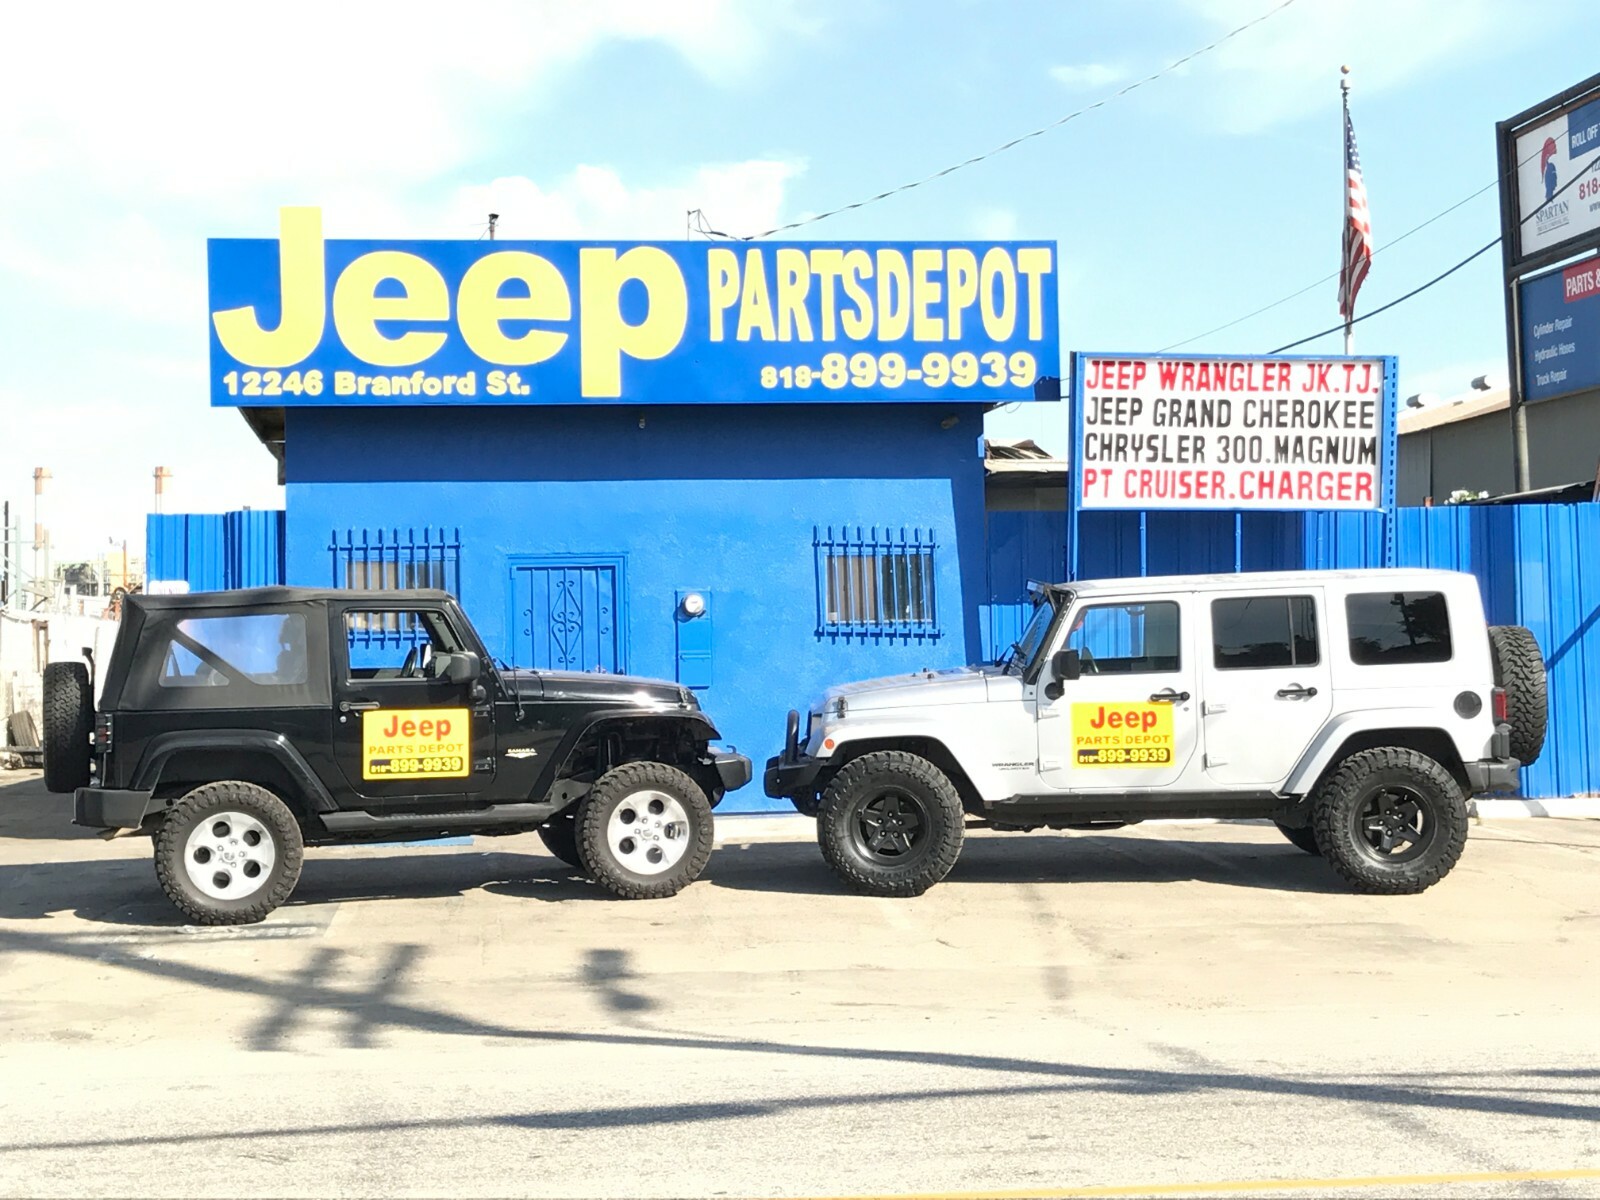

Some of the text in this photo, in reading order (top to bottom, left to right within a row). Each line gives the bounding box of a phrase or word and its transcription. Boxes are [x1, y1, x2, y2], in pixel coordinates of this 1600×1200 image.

[1566, 271, 1594, 298] PARTS
[212, 206, 689, 399] Jeep
[223, 371, 531, 396] 12246 Branford St.
[760, 352, 1037, 390] 818-899-9939
[1086, 360, 1147, 390] JEEP
[1158, 362, 1292, 392] WRANGLER
[1086, 396, 1375, 429] JEEP GRAND CHEROKEE
[1085, 432, 1206, 464] CHRYSLER
[1083, 468, 1113, 498] PT
[384, 715, 451, 742] Jeep
[1090, 706, 1157, 733] Jeep
[369, 743, 464, 755] PARTS DEPOT
[1077, 735, 1170, 745] PARTS DEPOT
